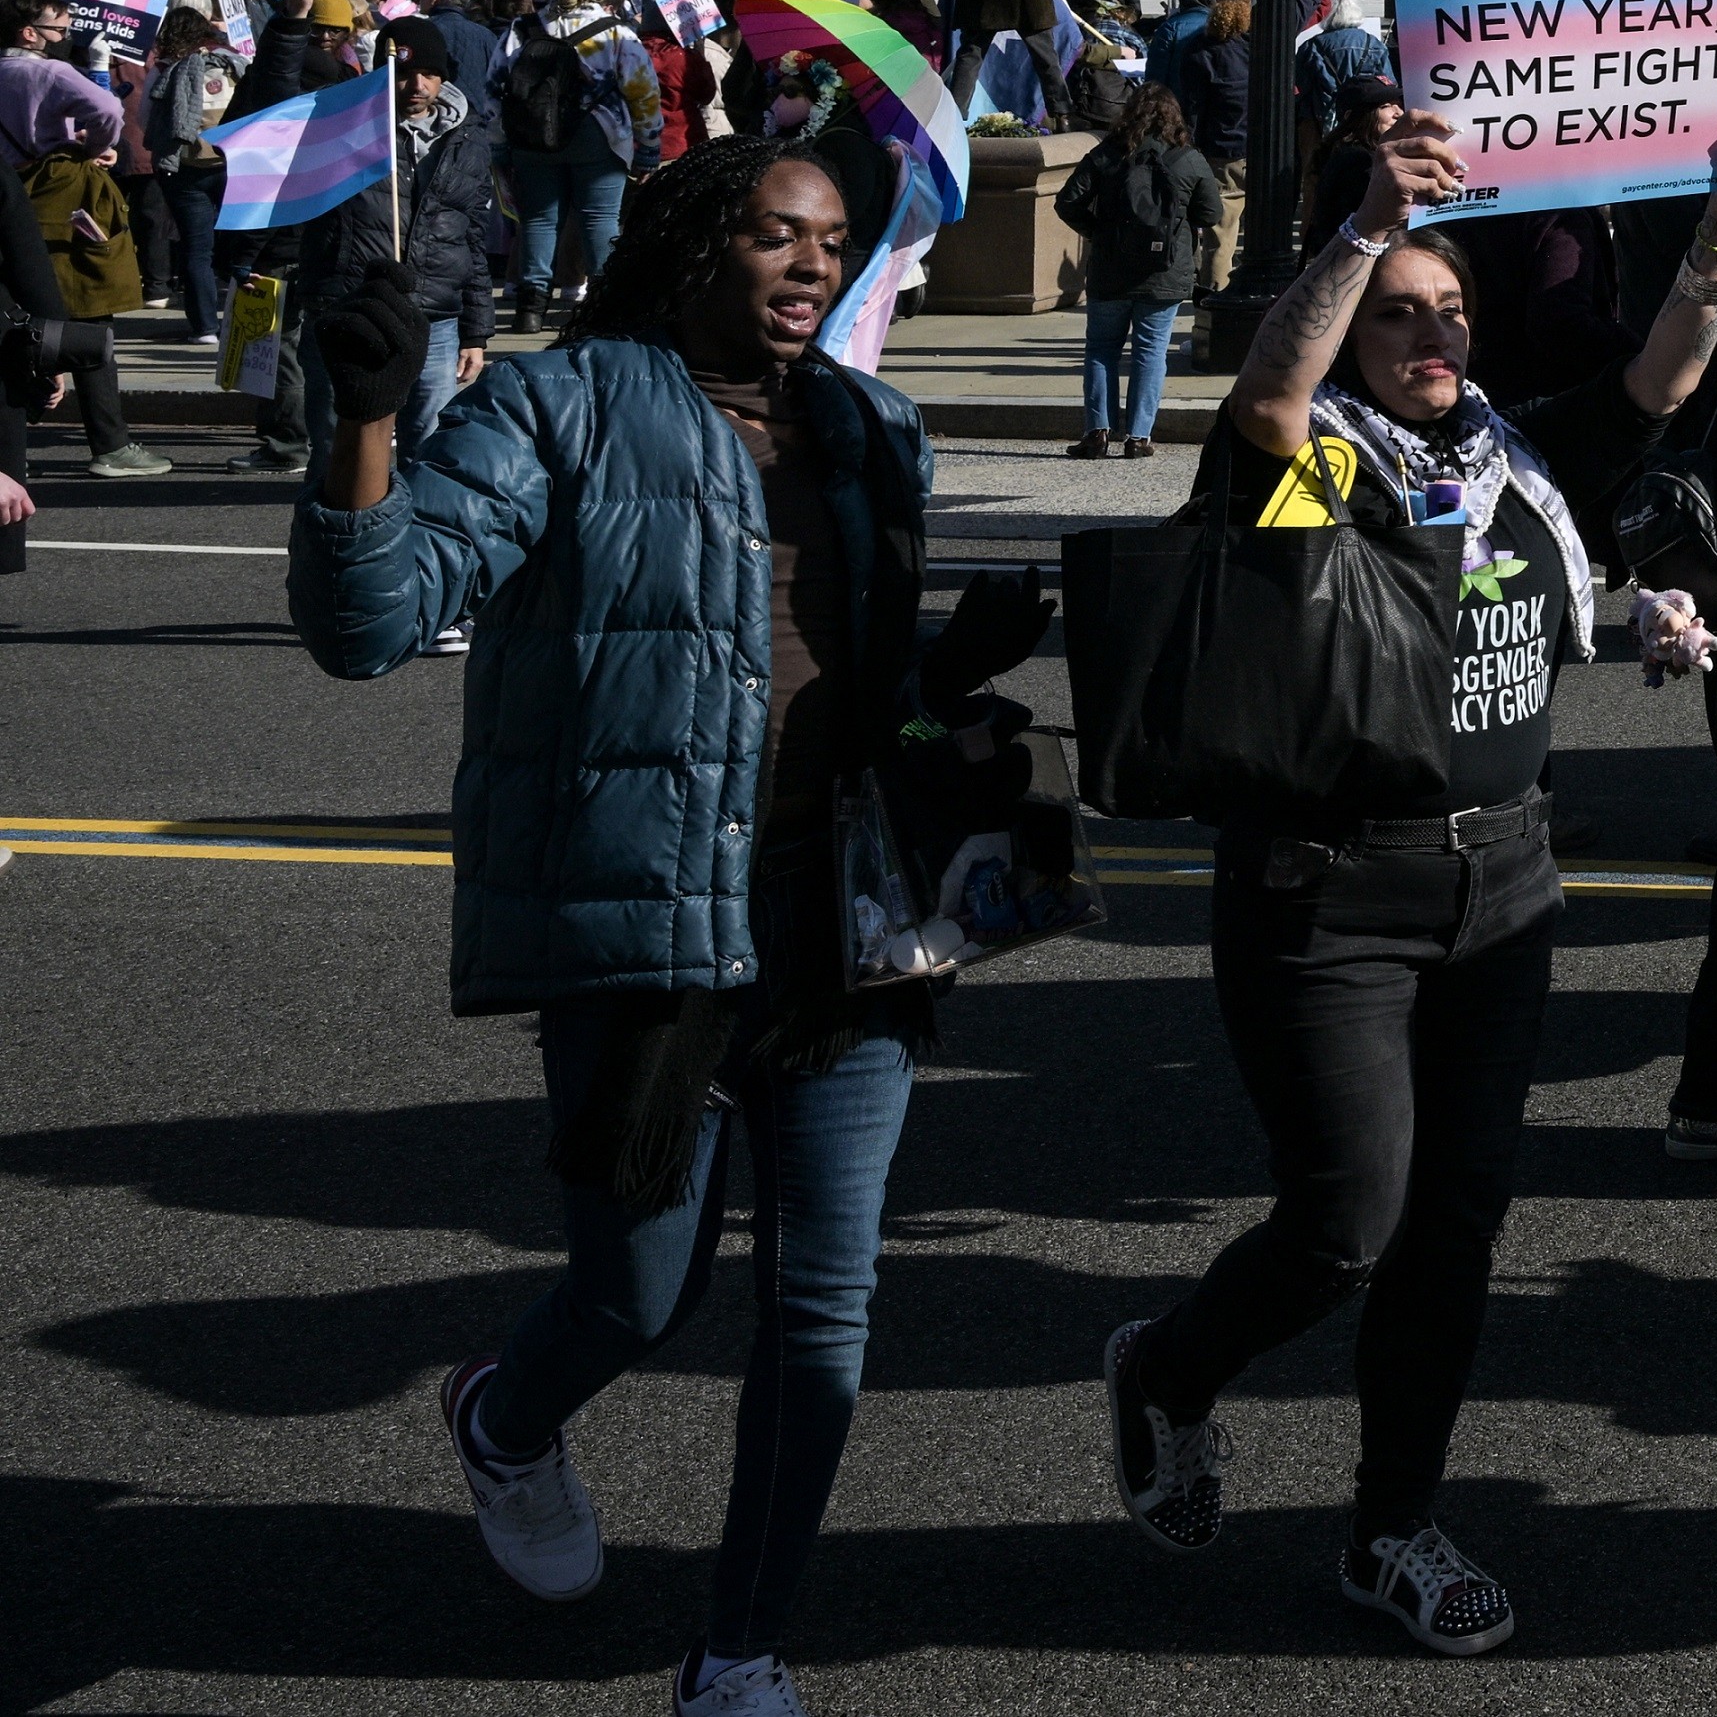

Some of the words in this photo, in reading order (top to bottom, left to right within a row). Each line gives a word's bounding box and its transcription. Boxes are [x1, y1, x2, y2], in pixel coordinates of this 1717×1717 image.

[67, 2, 100, 18] God
[102, 8, 141, 28] loves
[69, 17, 103, 31] rans
[106, 21, 136, 39] kids
[696, 8, 714, 23] LIKE
[1434, 0, 1566, 46] NEW
[1429, 55, 1576, 102] SAME
[1472, 113, 1538, 154] TO
[1554, 99, 1691, 146] EXIST.
[1470, 593, 1546, 651] YORK
